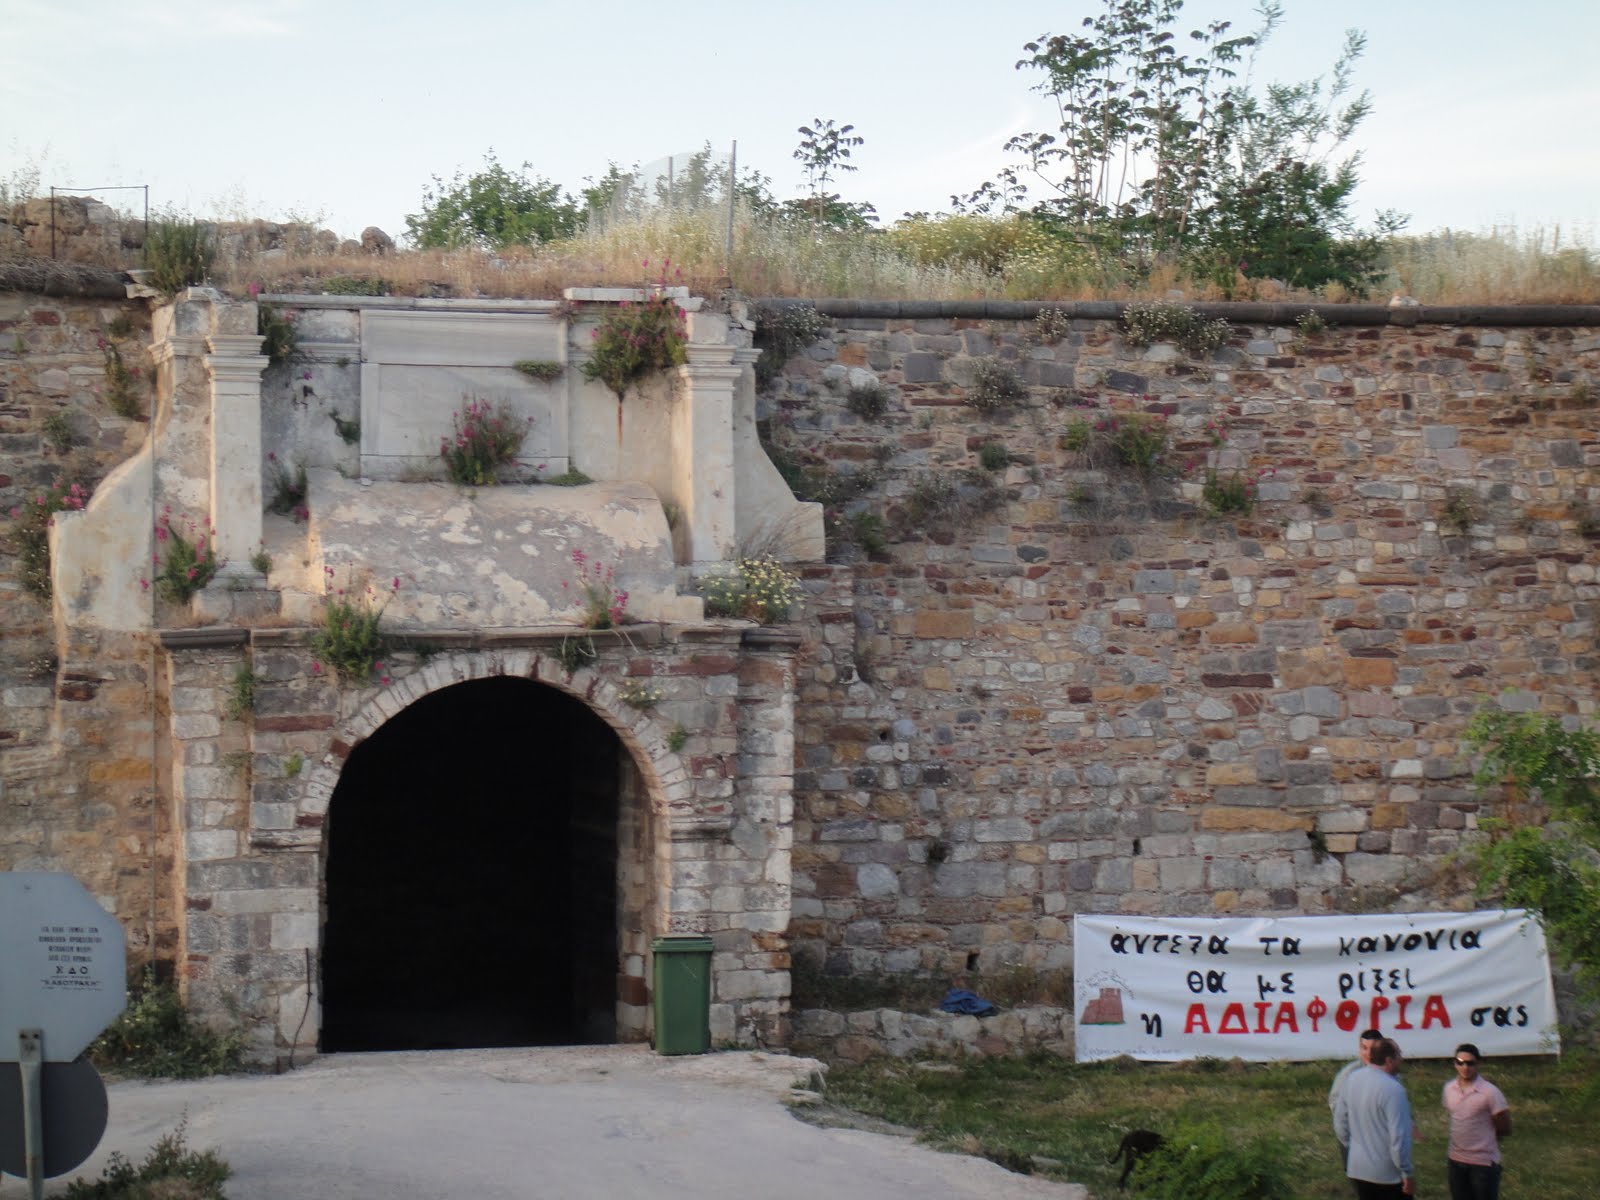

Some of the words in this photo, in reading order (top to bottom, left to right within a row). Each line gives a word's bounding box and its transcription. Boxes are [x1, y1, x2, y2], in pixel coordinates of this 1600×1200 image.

[1258, 935, 1302, 956] τα
[1186, 969, 1228, 994] θα
[1256, 971, 1296, 1001] με
[1140, 1012, 1163, 1038] η
[1183, 994, 1452, 1035] ΑΔΙΑΦΟΡΙΑ
[1470, 1004, 1529, 1028] σας
